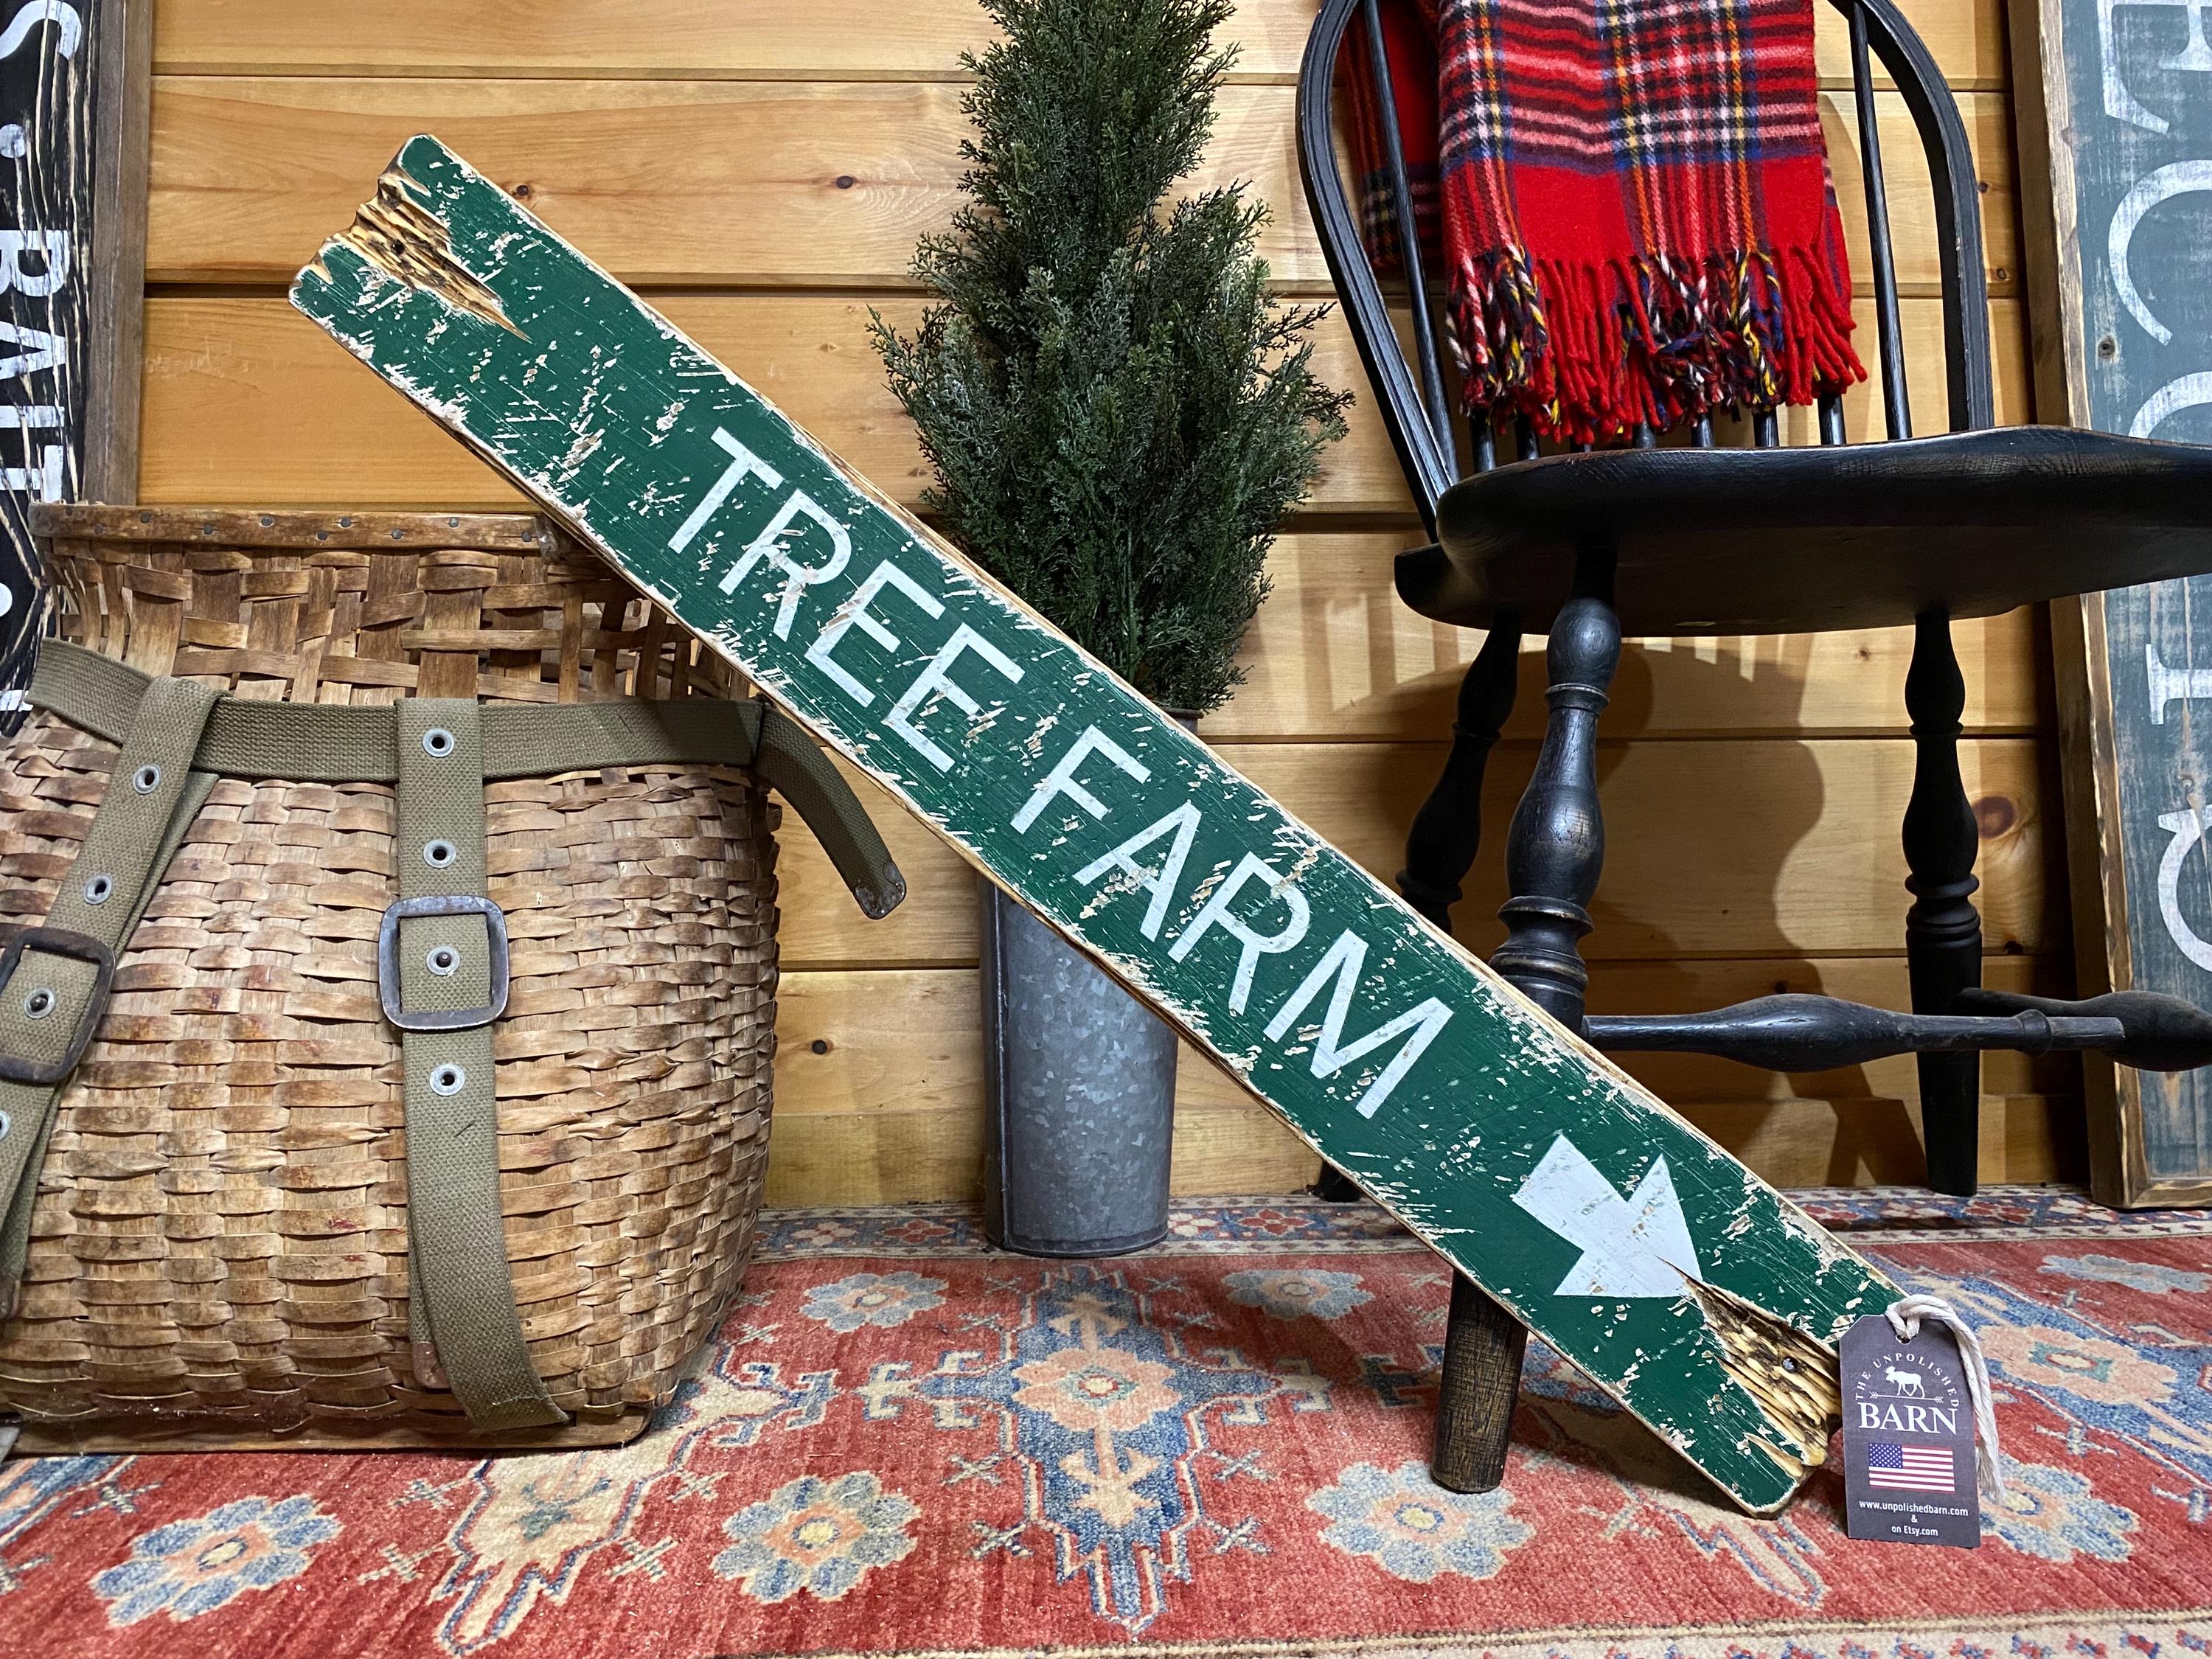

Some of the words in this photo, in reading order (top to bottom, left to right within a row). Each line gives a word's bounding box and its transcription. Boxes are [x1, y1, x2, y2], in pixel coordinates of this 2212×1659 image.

[667, 426, 1026, 773] TREE
[1009, 724, 1453, 1119] FARM
[1855, 1371, 1871, 1400] THE
[1872, 1352, 1959, 1407] UNPOLISHED
[1857, 1402, 1958, 1435] BARN
[1859, 1500, 1969, 1517] www.unpolishedbarn.com
[1910, 1514, 1918, 1523] &
[1903, 1525, 1938, 1537] Etsy.com
